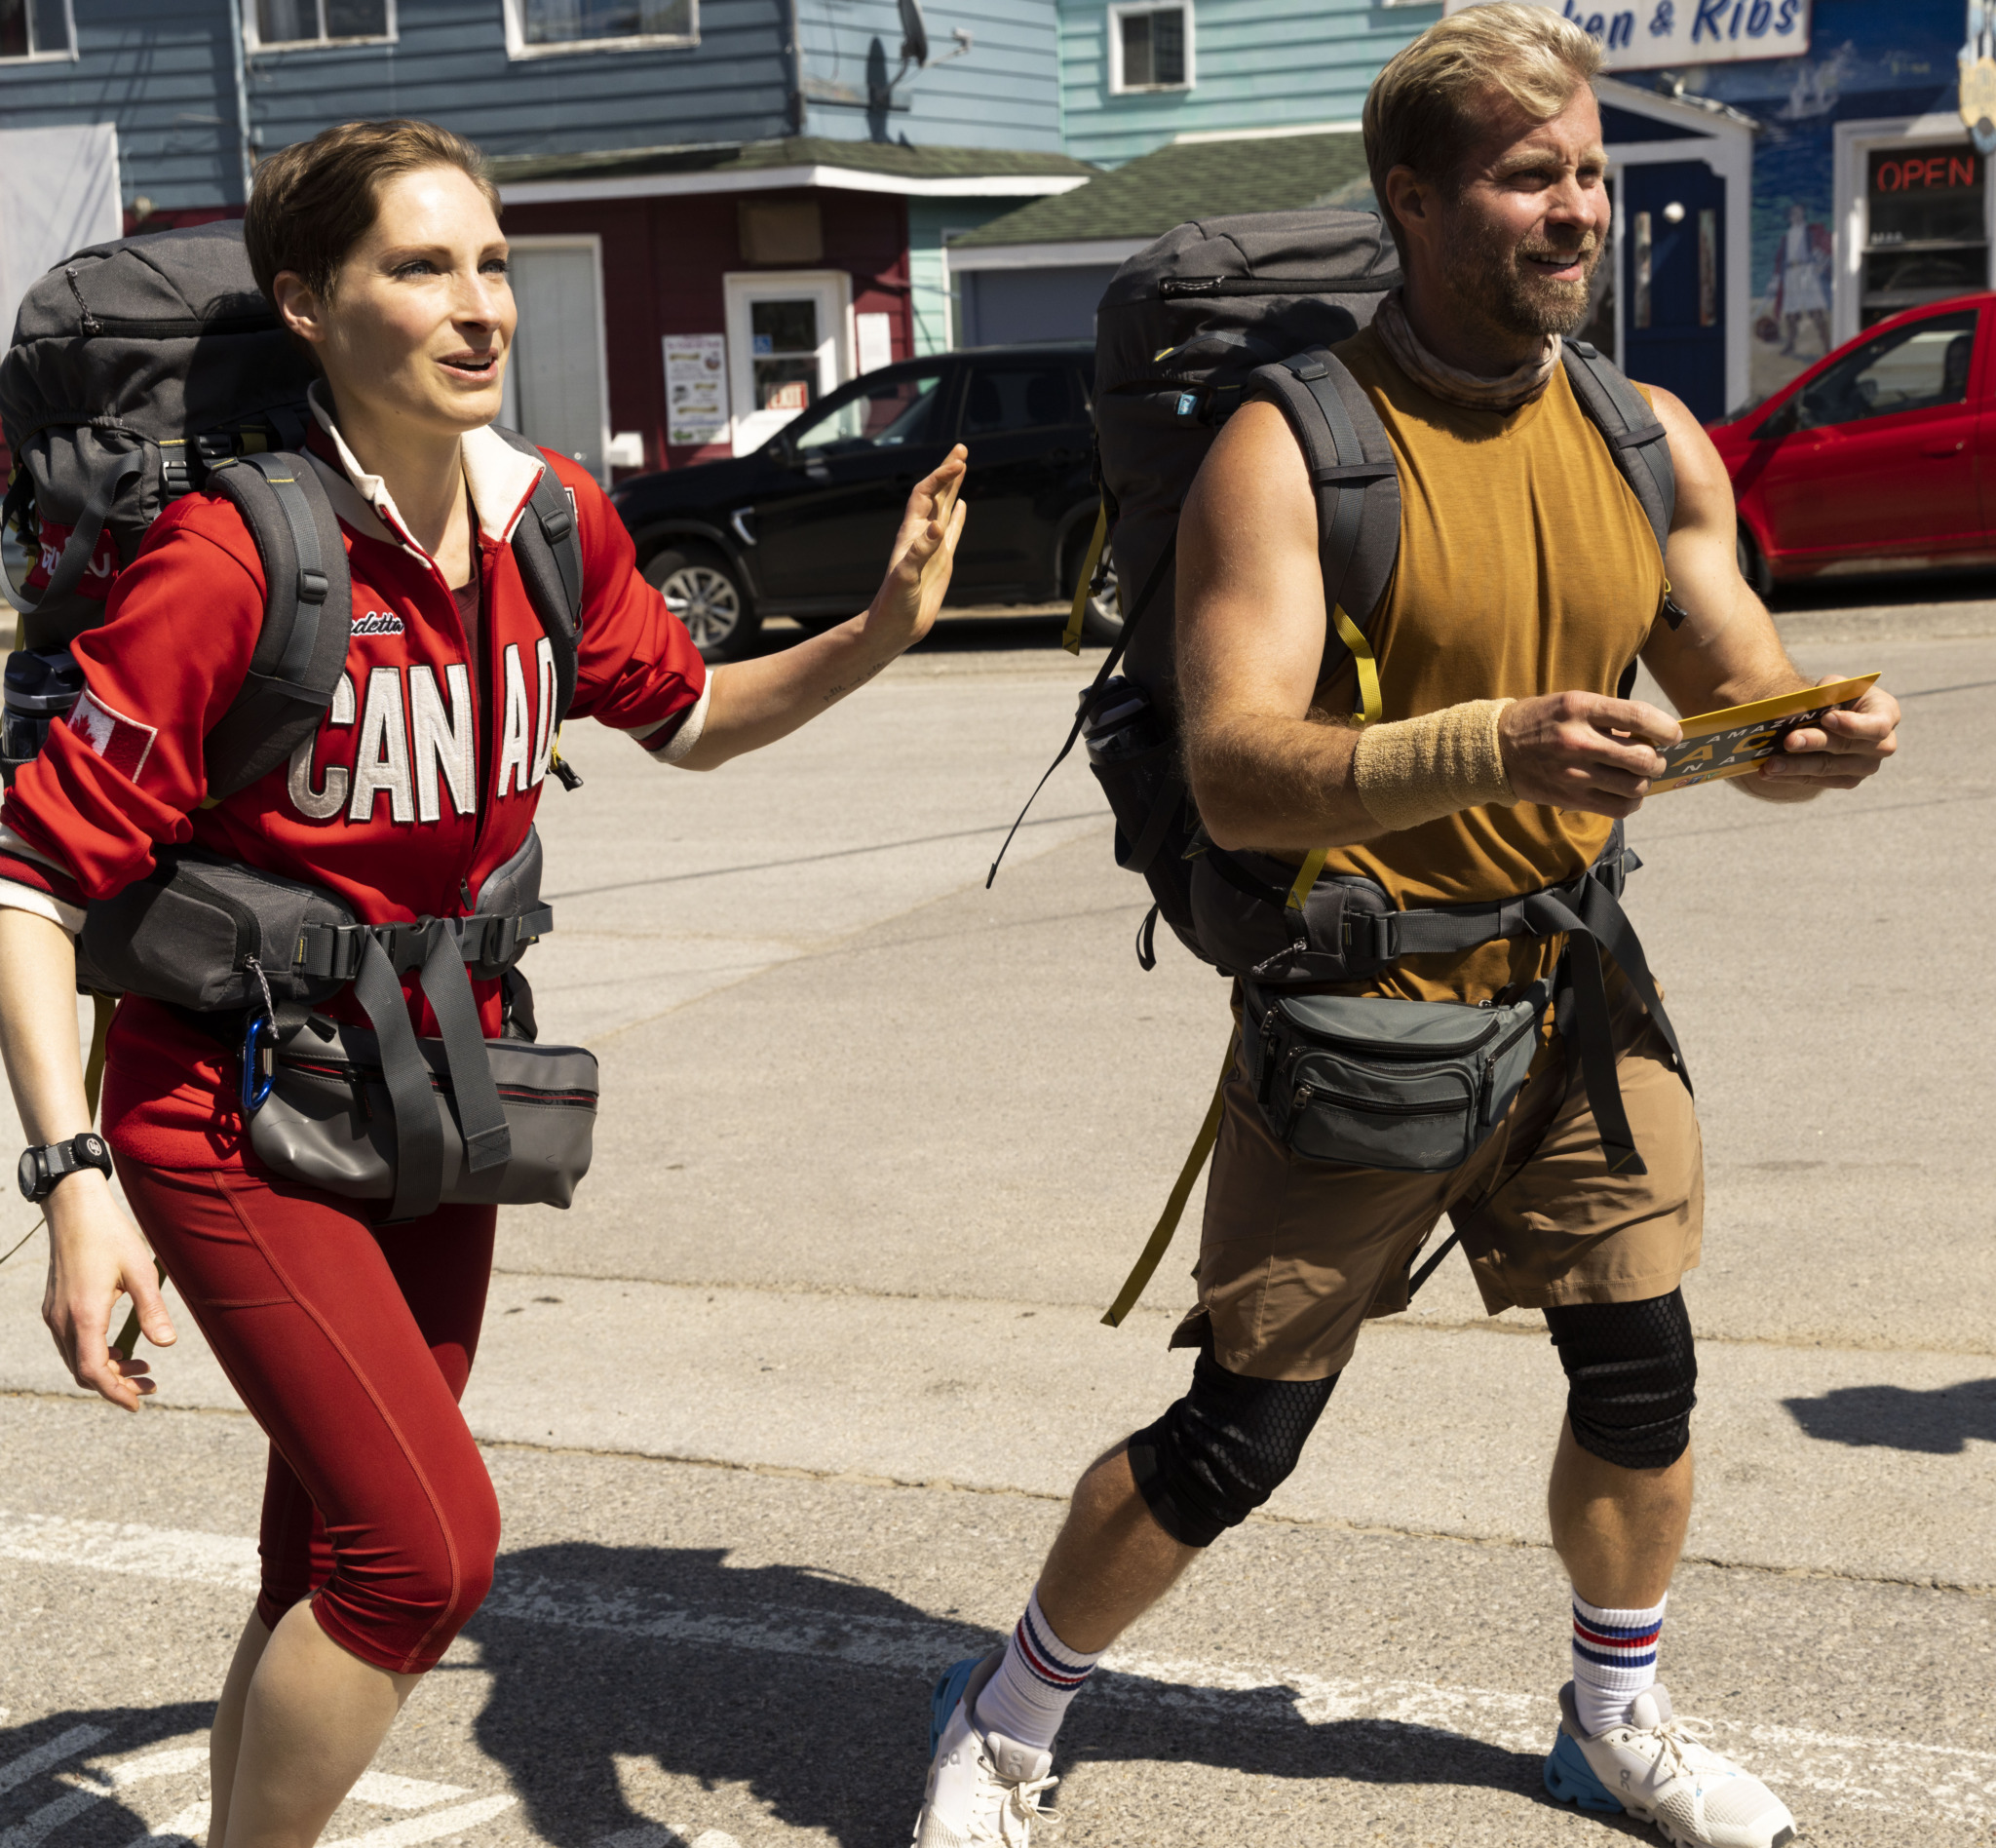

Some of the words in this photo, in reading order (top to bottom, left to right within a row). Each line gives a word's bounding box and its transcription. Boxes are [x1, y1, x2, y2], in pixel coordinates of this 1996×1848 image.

[1563, 0, 1634, 50] en
[1649, 0, 1675, 37] &
[1877, 156, 1974, 192] OPEN
[351, 611, 404, 636] detta
